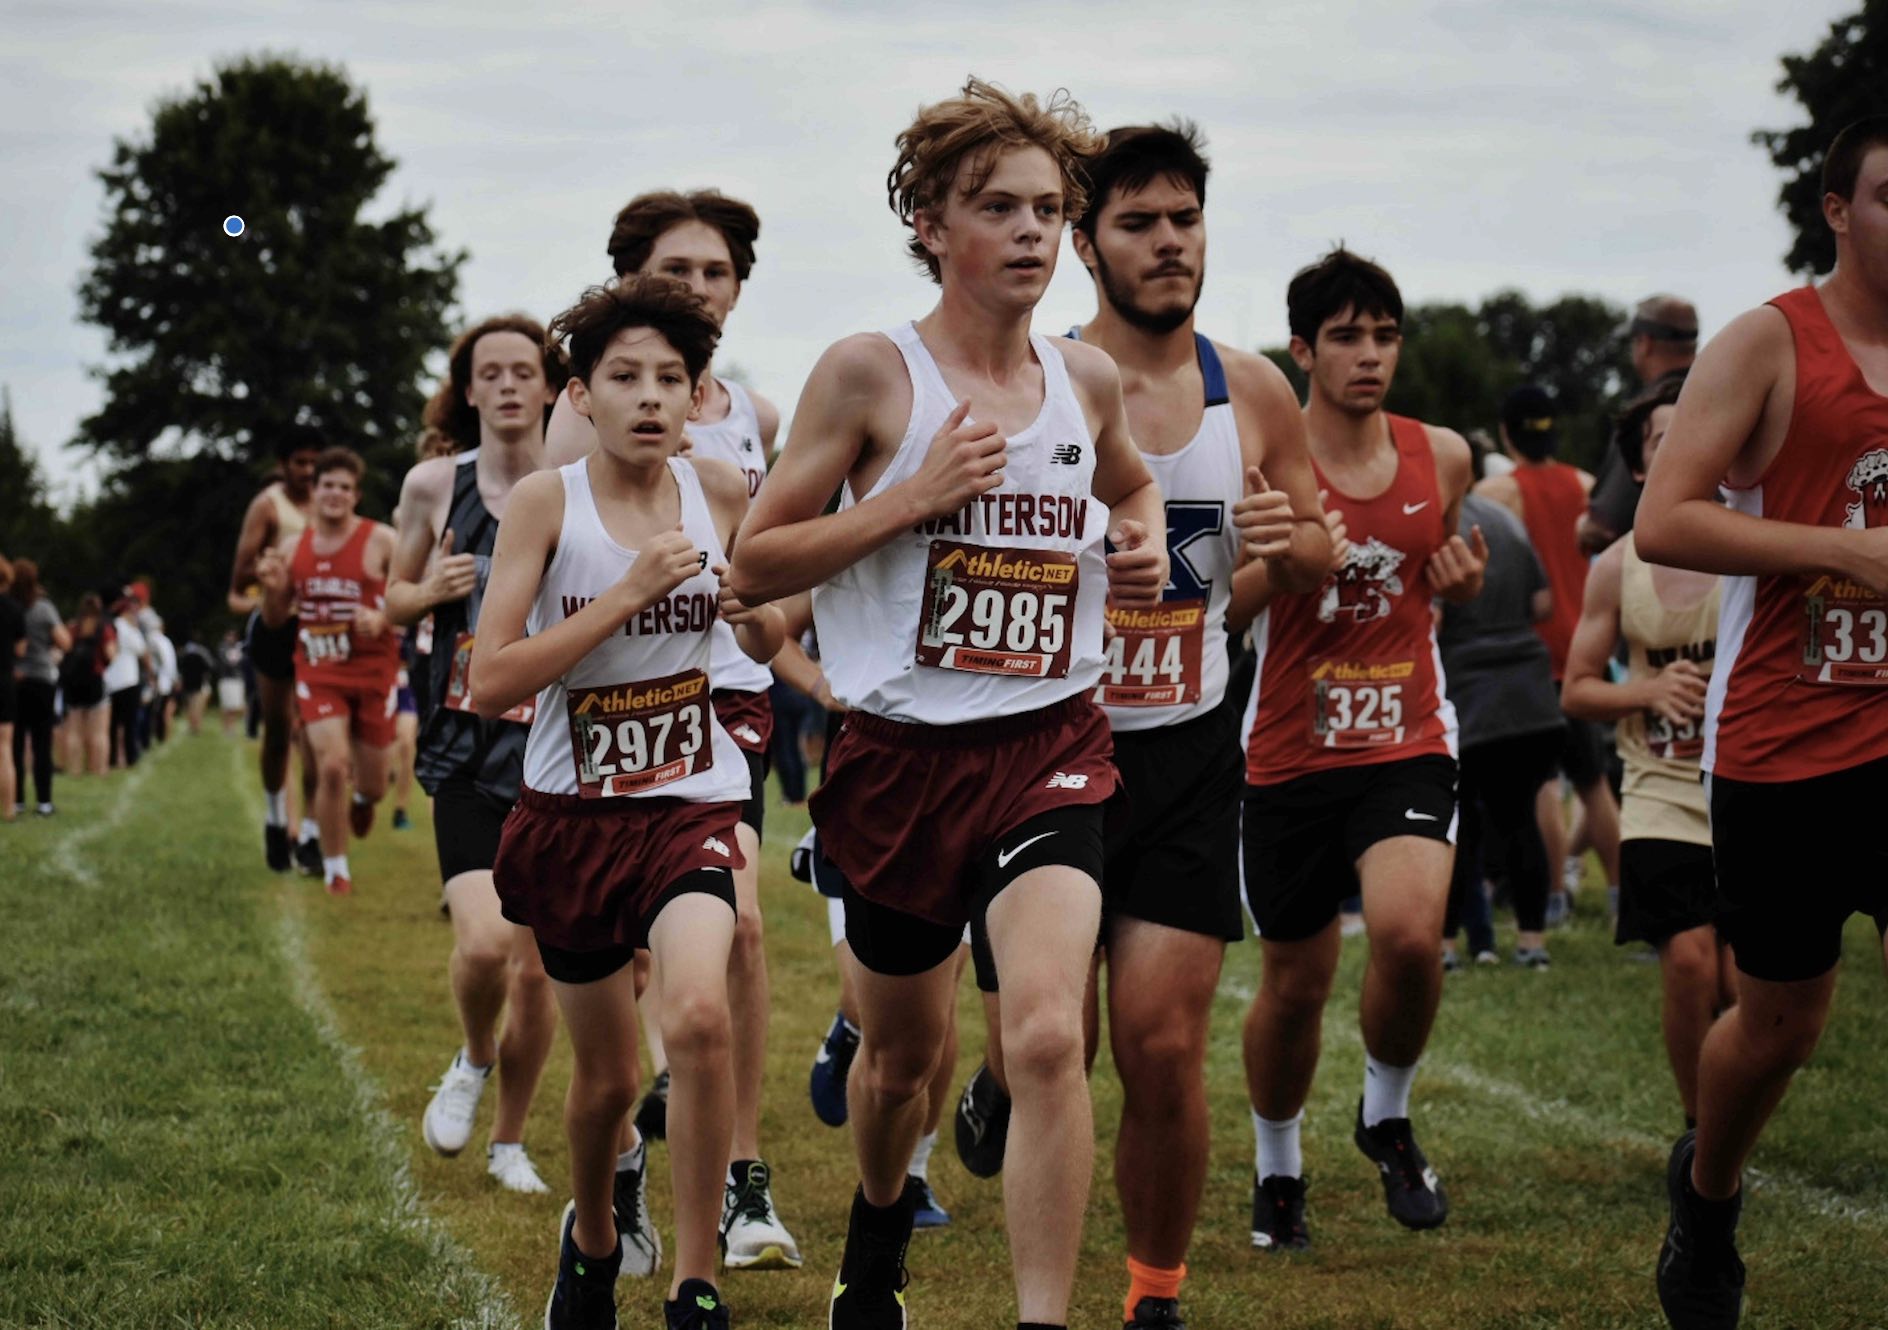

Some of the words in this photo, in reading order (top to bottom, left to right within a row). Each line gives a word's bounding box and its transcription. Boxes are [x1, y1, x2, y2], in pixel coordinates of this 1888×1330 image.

[934, 549, 1042, 580] Athletic
[1162, 501, 1224, 613] K
[562, 593, 719, 636] WERSON
[938, 585, 1068, 653] 2985
[1106, 609, 1171, 628] thletic
[1824, 609, 1887, 662] 33
[1103, 635, 1184, 685] 444
[575, 688, 673, 714] Athletic
[1328, 685, 1402, 729] 325
[587, 704, 702, 775] 2973
